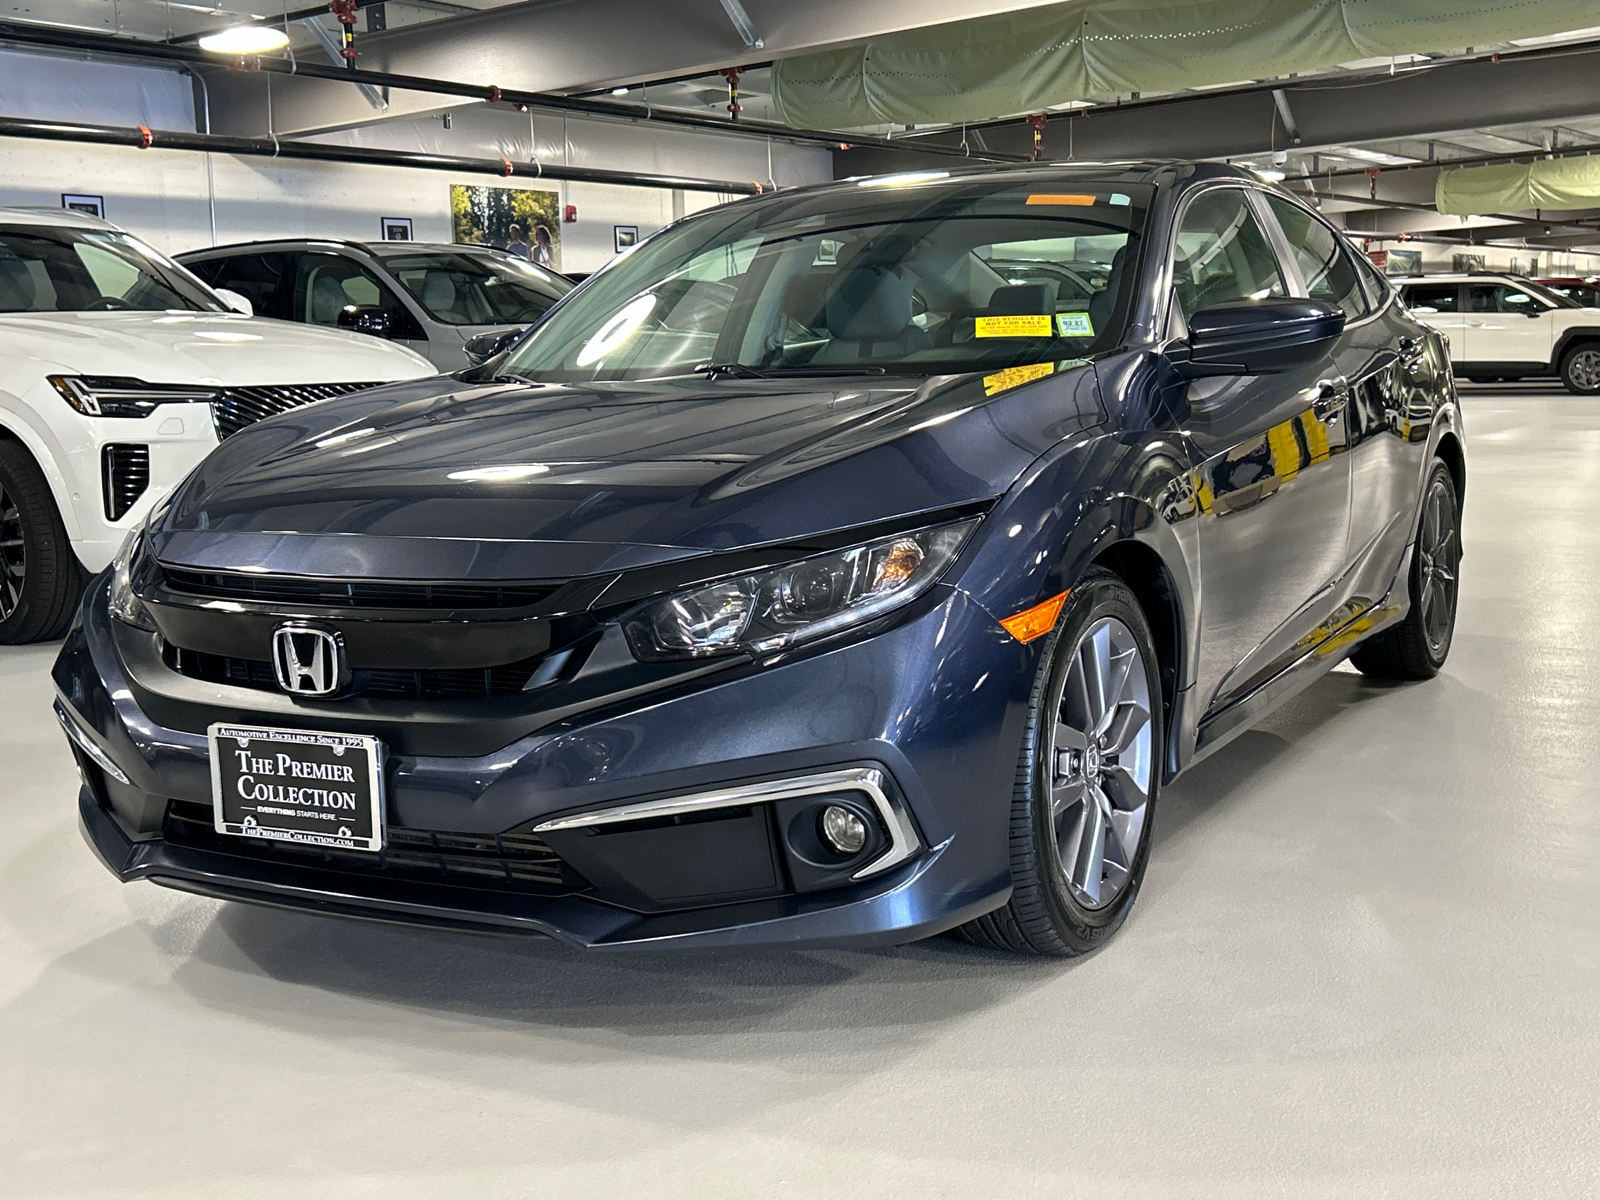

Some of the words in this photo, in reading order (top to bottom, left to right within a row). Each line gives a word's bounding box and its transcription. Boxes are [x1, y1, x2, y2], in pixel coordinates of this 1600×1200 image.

[220, 728, 268, 739] AUTOMOTIVE
[269, 731, 316, 743] EXCELLENCE
[317, 734, 340, 745] SINCE
[342, 737, 363, 747] 1995
[235, 749, 274, 775] THE
[275, 753, 355, 783] PREMIER
[237, 775, 356, 810] COLLECTION
[257, 805, 296, 816] EVERYTHING
[296, 808, 319, 819] STARTS
